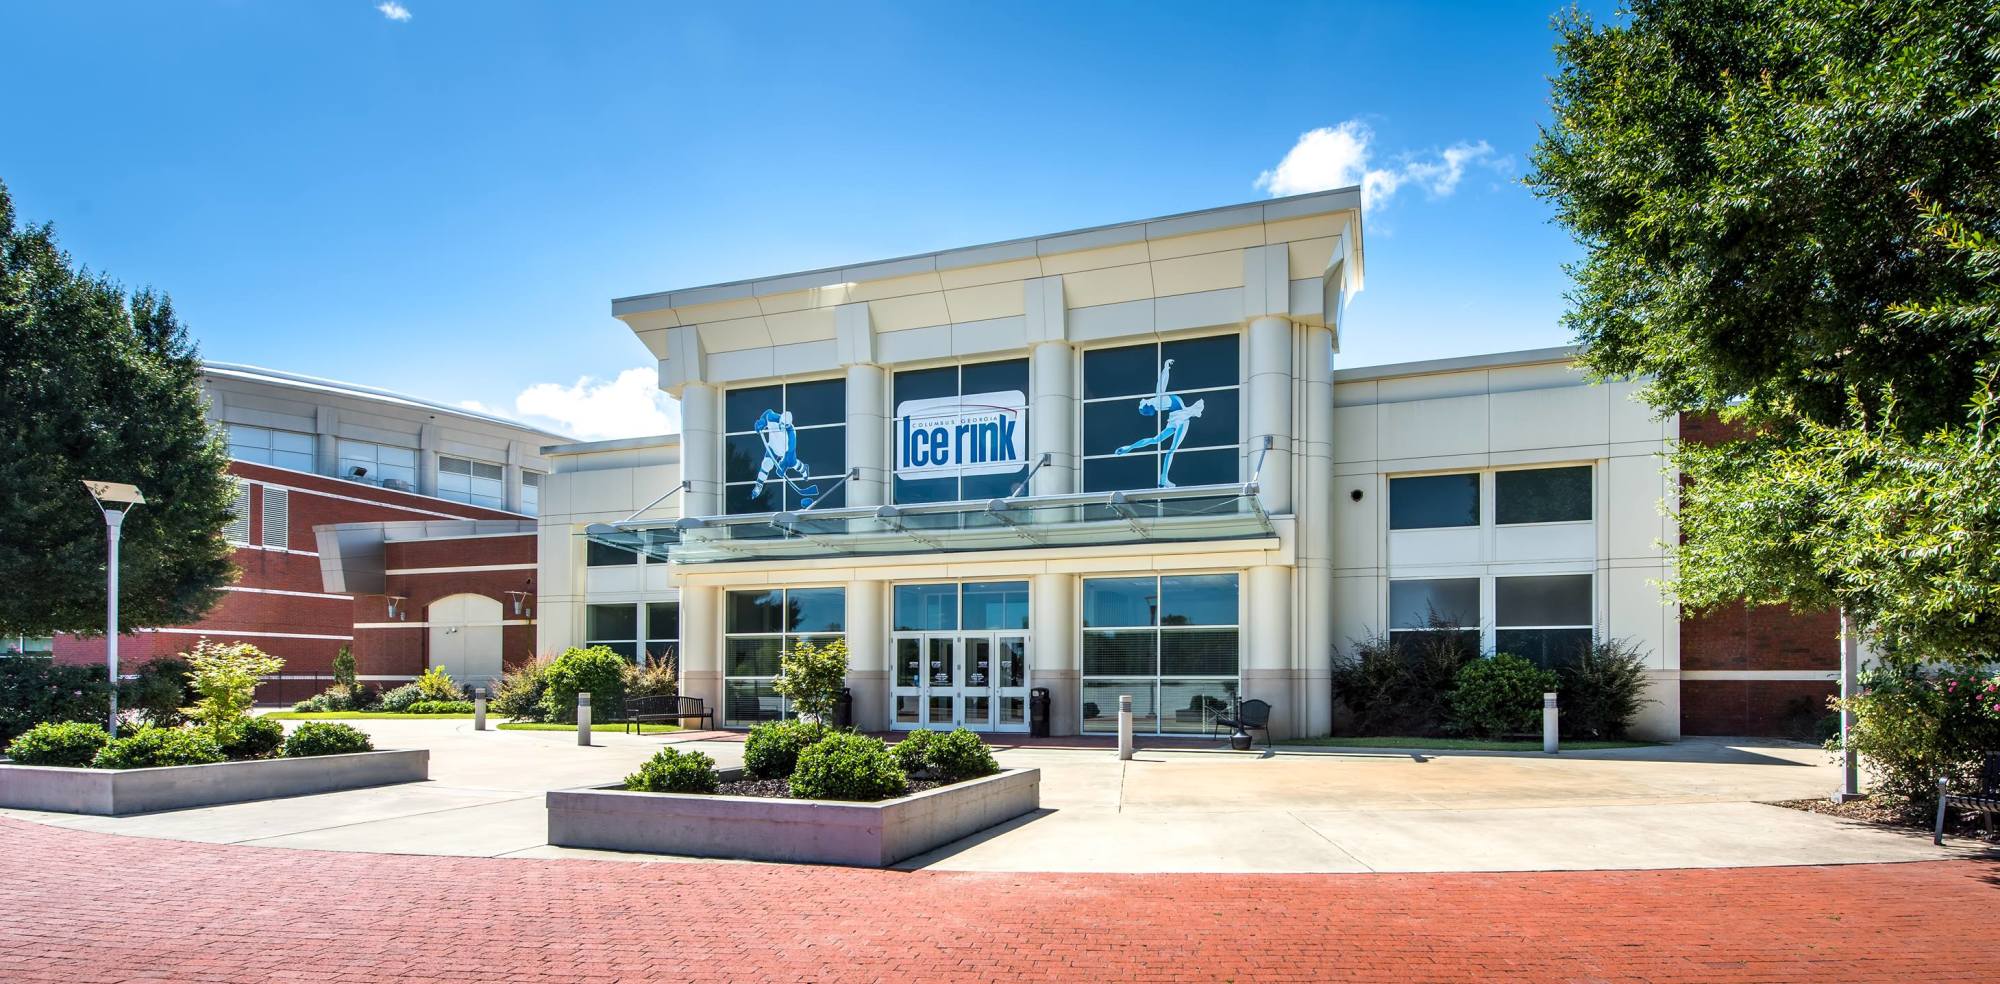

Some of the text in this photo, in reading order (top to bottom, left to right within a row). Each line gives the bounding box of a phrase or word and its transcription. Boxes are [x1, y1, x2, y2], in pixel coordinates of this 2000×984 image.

[912, 416, 998, 428] COLUMBUS GEORGIA
[903, 413, 1017, 468] Ice rink
